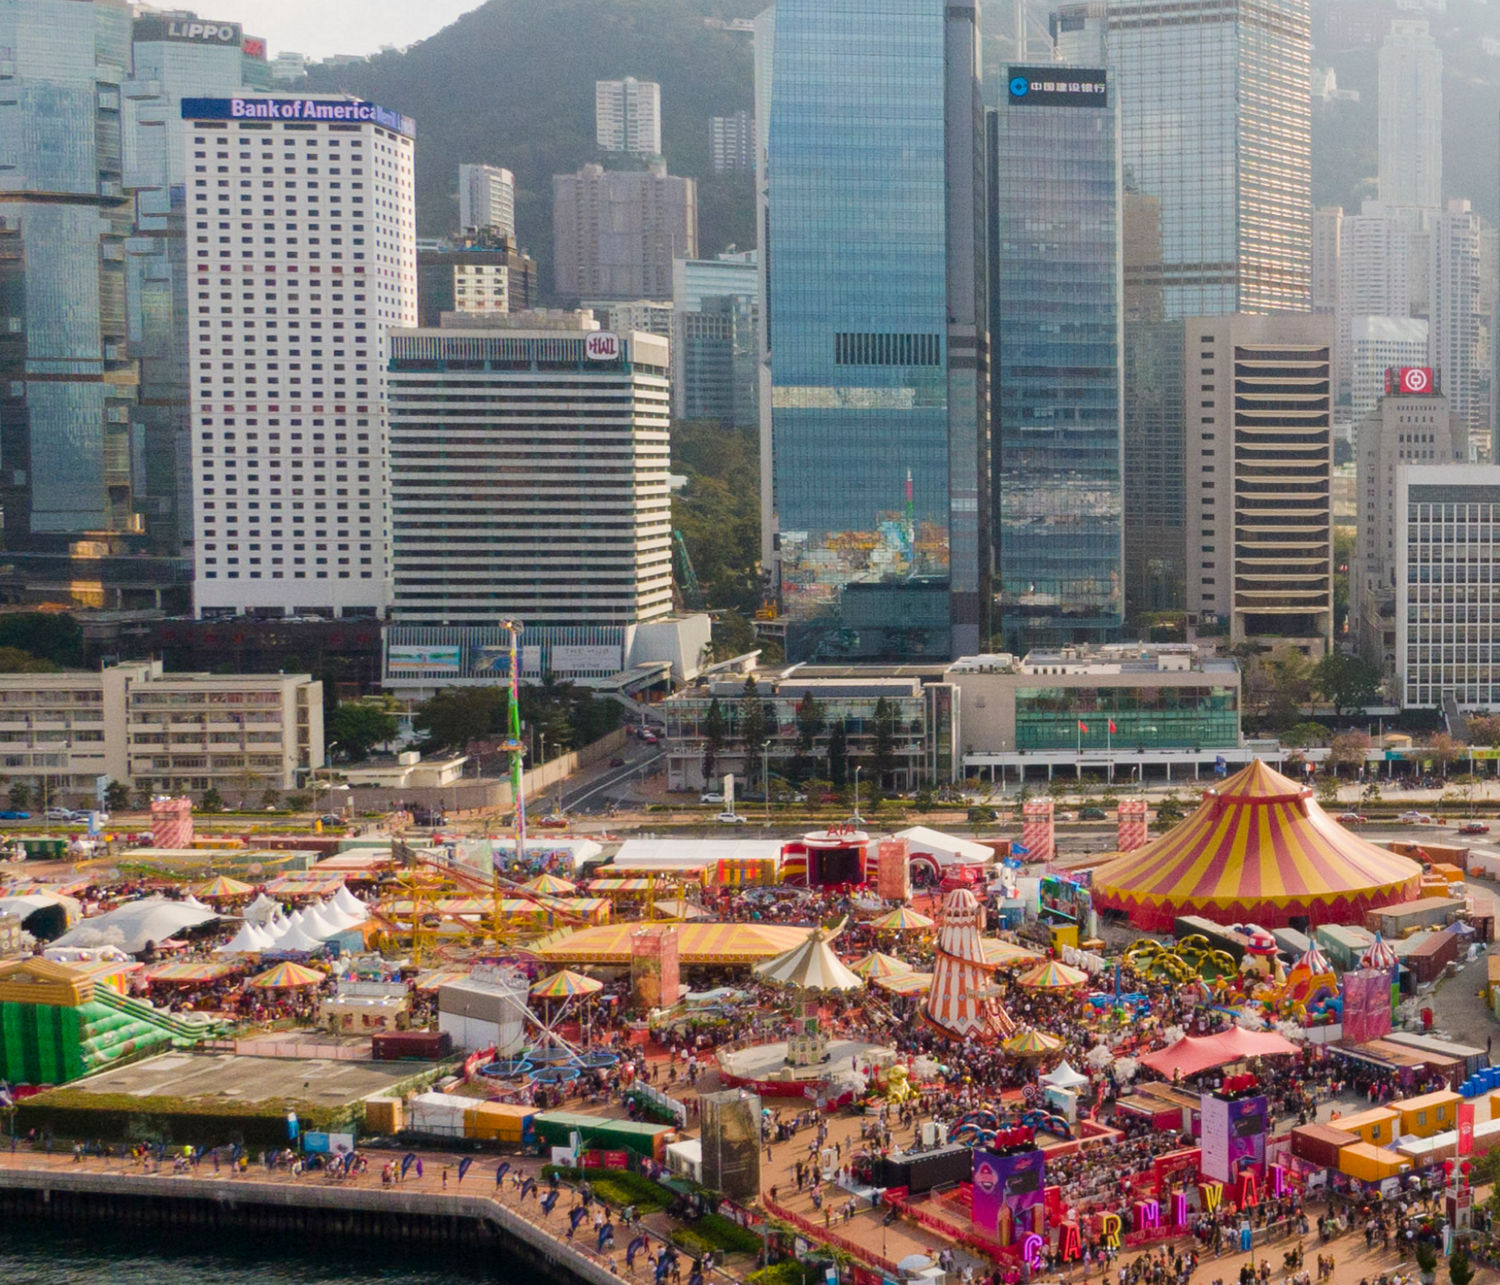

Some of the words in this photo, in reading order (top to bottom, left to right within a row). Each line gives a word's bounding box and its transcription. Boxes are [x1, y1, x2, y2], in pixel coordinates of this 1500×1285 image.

[168, 22, 234, 41] LIPPO
[1030, 82, 1106, 93] 中国建设银行
[231, 99, 280, 118] Bank
[281, 100, 302, 118] of
[303, 101, 376, 120] America
[826, 823, 857, 836] AIA
[1023, 1163, 1293, 1270] CARNIVAL
